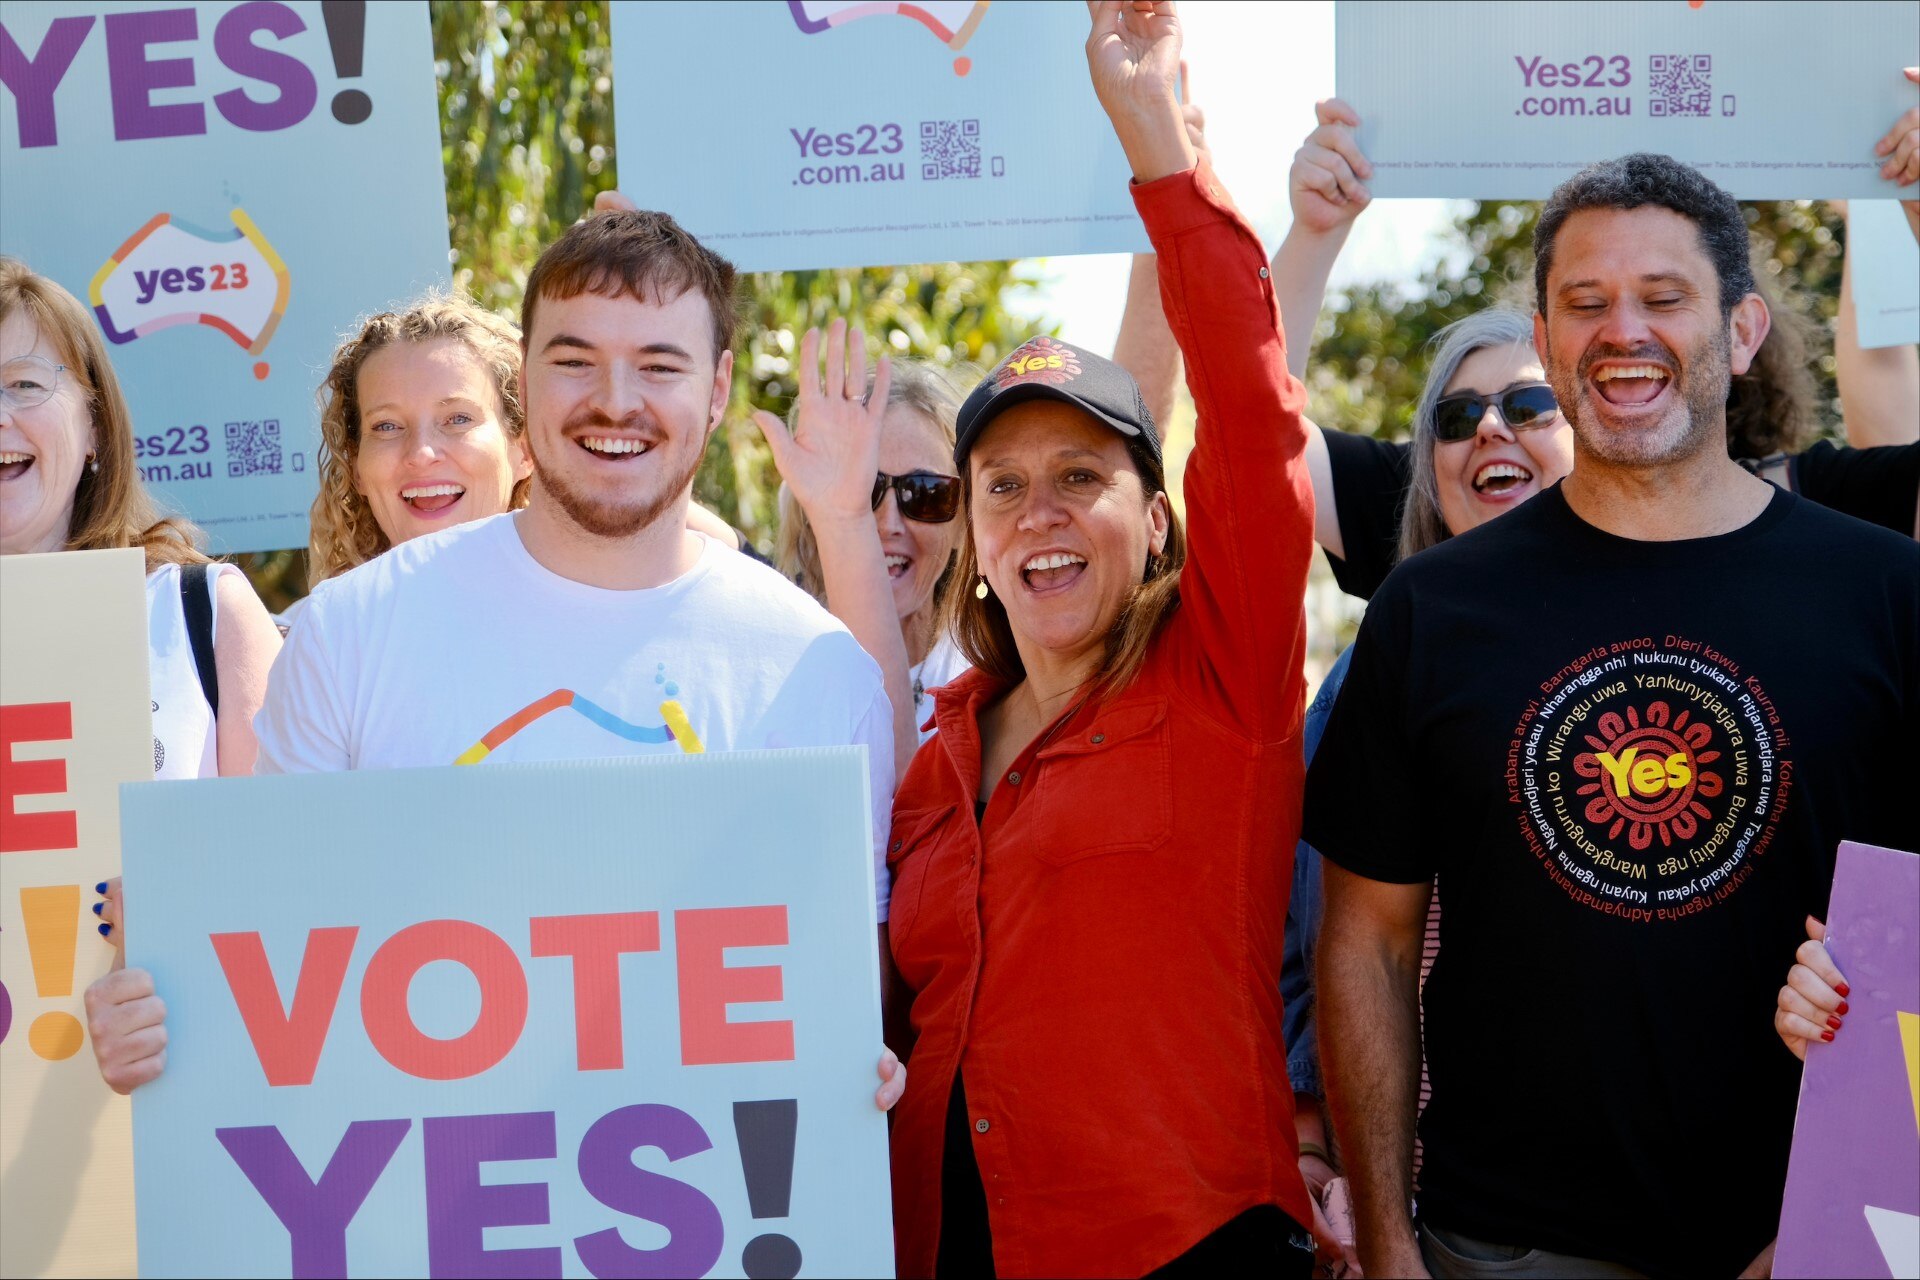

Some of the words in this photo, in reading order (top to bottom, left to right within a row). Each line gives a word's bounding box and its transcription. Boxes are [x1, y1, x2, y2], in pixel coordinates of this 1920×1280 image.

[0, 0, 374, 149] YES!
[1514, 54, 1632, 88] Yes23
[1514, 96, 1631, 117] .com.au
[789, 122, 904, 158] Yes23
[791, 162, 905, 186] .com.au
[133, 262, 249, 304] yes23
[1007, 354, 1063, 376] Yes
[1604, 655, 1626, 671] nhi
[1634, 651, 1687, 666] Nukunu
[1690, 659, 1740, 693] tyukarti
[1540, 667, 1603, 719] Nharangga
[1592, 682, 1627, 702] uwa
[1634, 674, 1743, 747] Yankunytjatjara
[1525, 724, 1544, 765] yekau
[1546, 700, 1592, 761] Wirangu
[1547, 772, 1560, 792] ko
[1595, 747, 1692, 798] Yes
[1735, 750, 1747, 785] uwa
[1755, 787, 1770, 815] uwa
[1553, 796, 1646, 879] Wangkangurru
[1690, 795, 1746, 867] Bungaditj
[1558, 850, 1599, 888] nganha
[1657, 858, 1688, 875] nga
[1600, 883, 1647, 903] Kuyani
[1658, 879, 1699, 900] yekau
[208, 904, 795, 1087] VOTE
[214, 1098, 804, 1279] YES!
